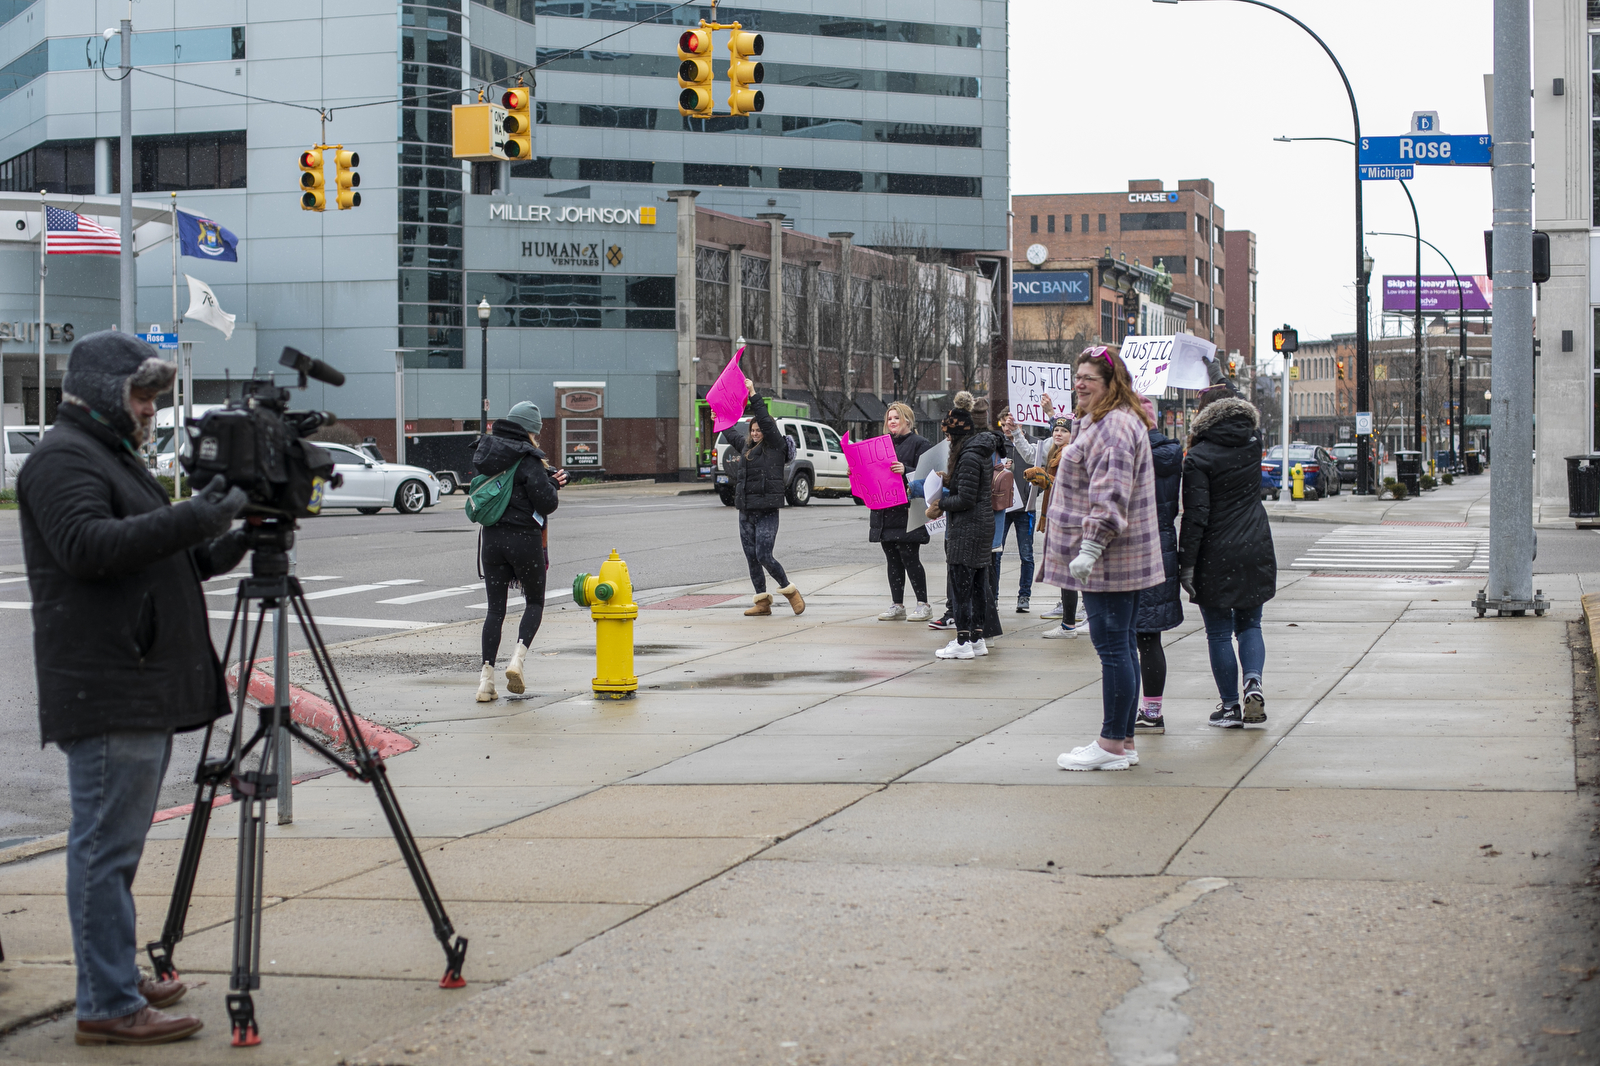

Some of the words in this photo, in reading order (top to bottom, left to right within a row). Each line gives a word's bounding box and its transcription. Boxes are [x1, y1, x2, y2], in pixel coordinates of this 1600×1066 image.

[494, 111, 505, 122] ONE
[1361, 139, 1369, 150] S
[1400, 138, 1451, 159] Rose
[1479, 137, 1489, 145] ST
[1368, 167, 1412, 180] Michigan
[1128, 193, 1167, 203] CHASE
[490, 203, 551, 222] MILLER
[556, 206, 640, 225] JOHNSON
[552, 258, 599, 267] VENTURES
[1012, 281, 1040, 295] PNC
[1040, 280, 1083, 294] BANK
[1387, 280, 1405, 288] Skip
[1420, 280, 1445, 288] heavy
[146, 334, 165, 342] Rose
[1139, 360, 1150, 377] 4
[1016, 403, 1066, 423] BAILY
